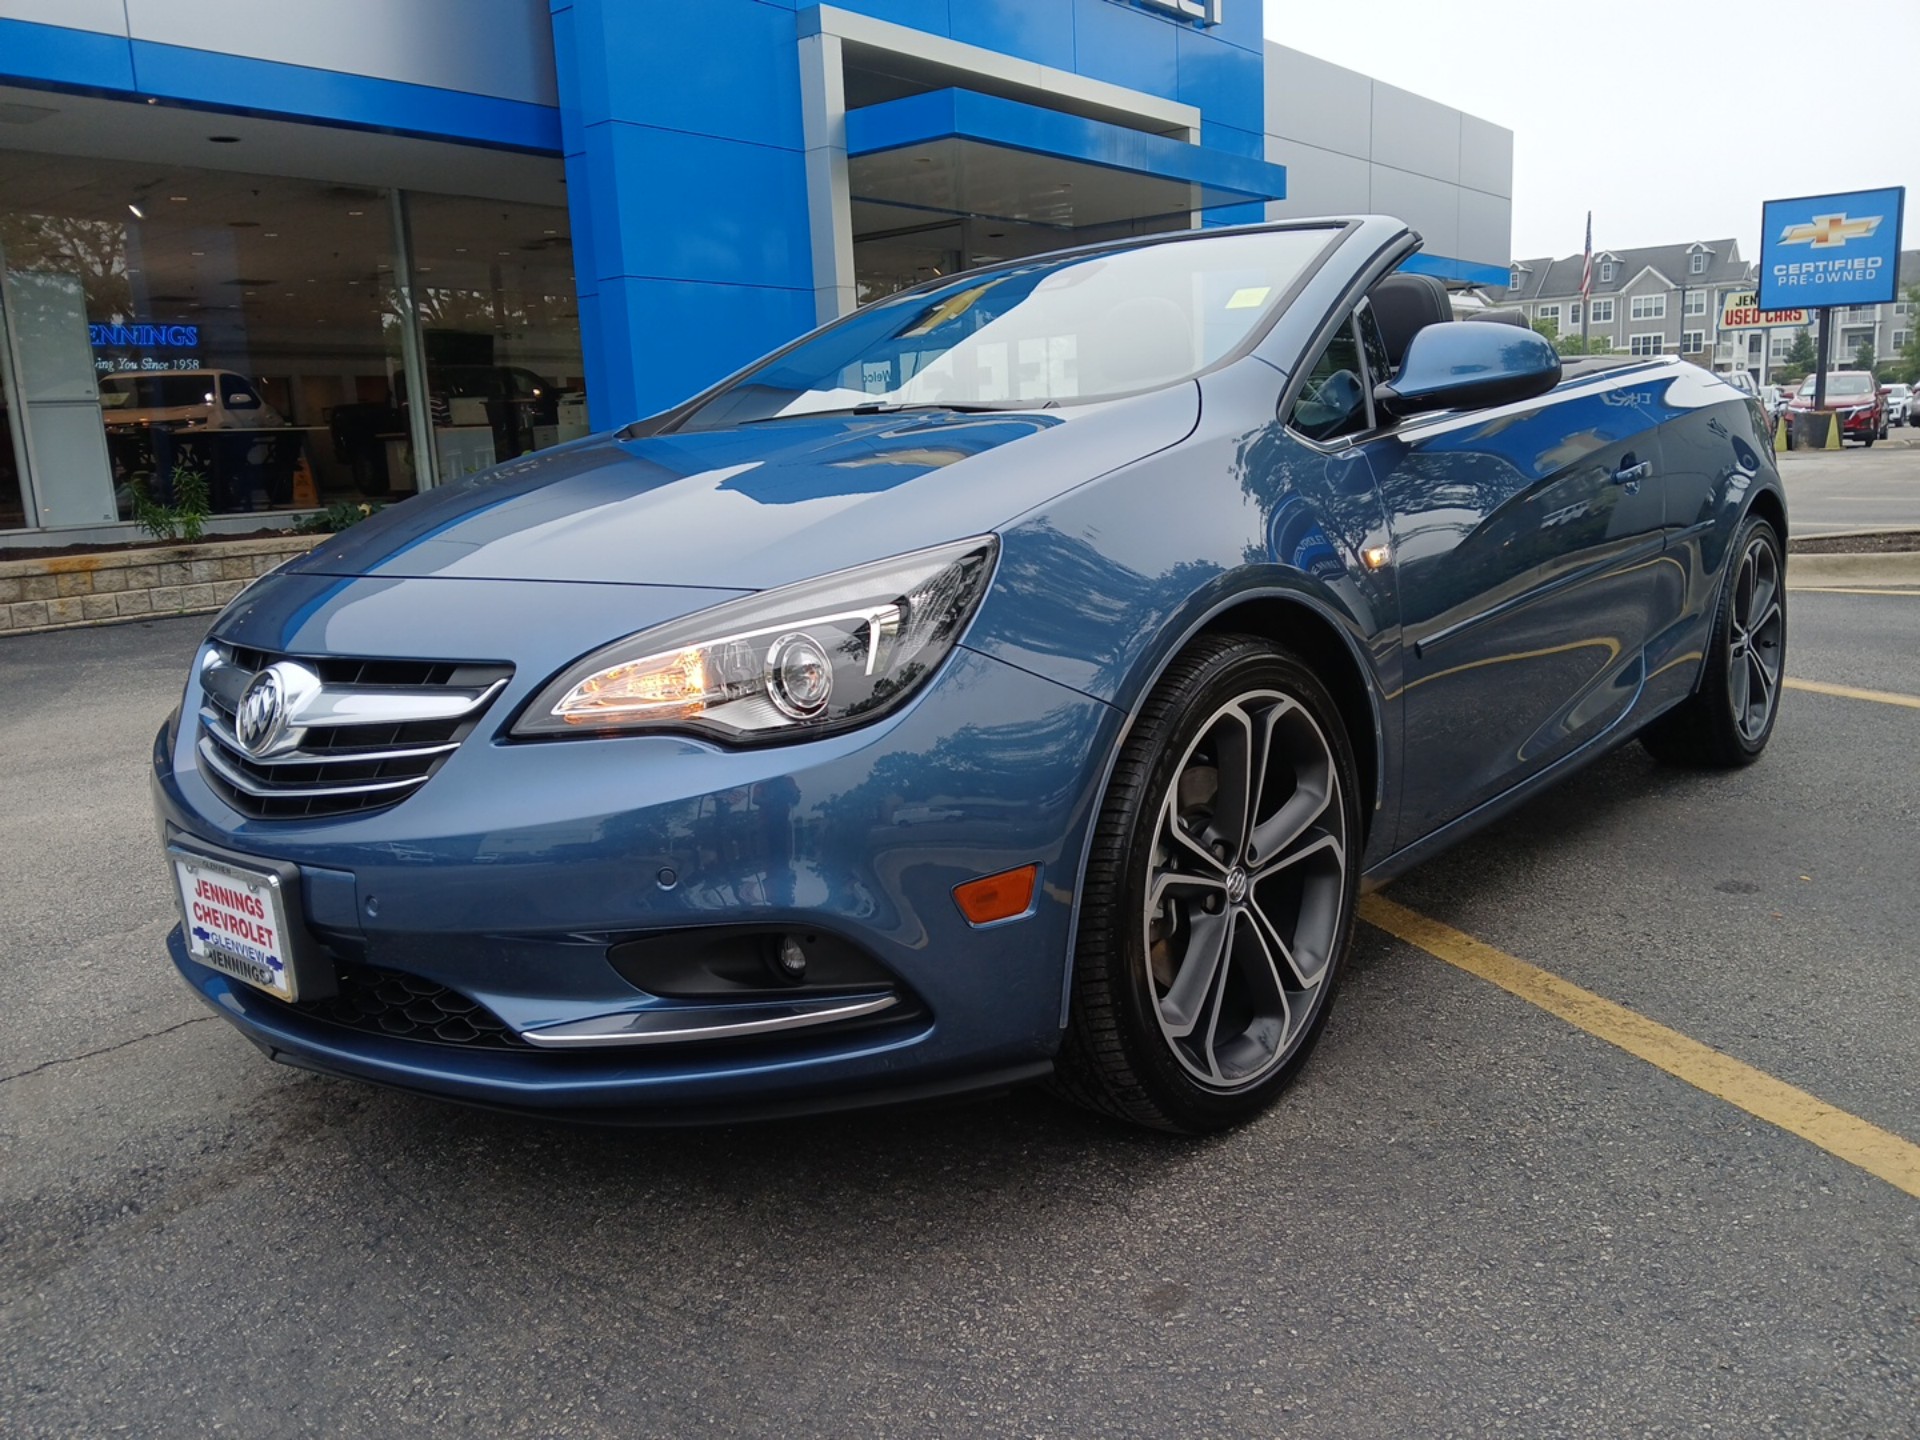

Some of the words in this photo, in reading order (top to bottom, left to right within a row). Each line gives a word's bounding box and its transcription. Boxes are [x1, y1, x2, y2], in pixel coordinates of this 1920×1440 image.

[1773, 256, 1883, 276] CERTIFIED
[1778, 269, 1876, 287] PRE-OWNED
[1735, 295, 1758, 307] JEN
[1725, 307, 1760, 326] USED
[88, 324, 198, 346] ENNINGS
[118, 358, 138, 370] You
[141, 357, 169, 370] Since
[173, 359, 200, 370] 1958
[195, 878, 265, 920] JENNINGS
[193, 902, 273, 949] CHEVROLET
[211, 932, 266, 964] GLENVIEW
[209, 952, 268, 985] JENNINGS
